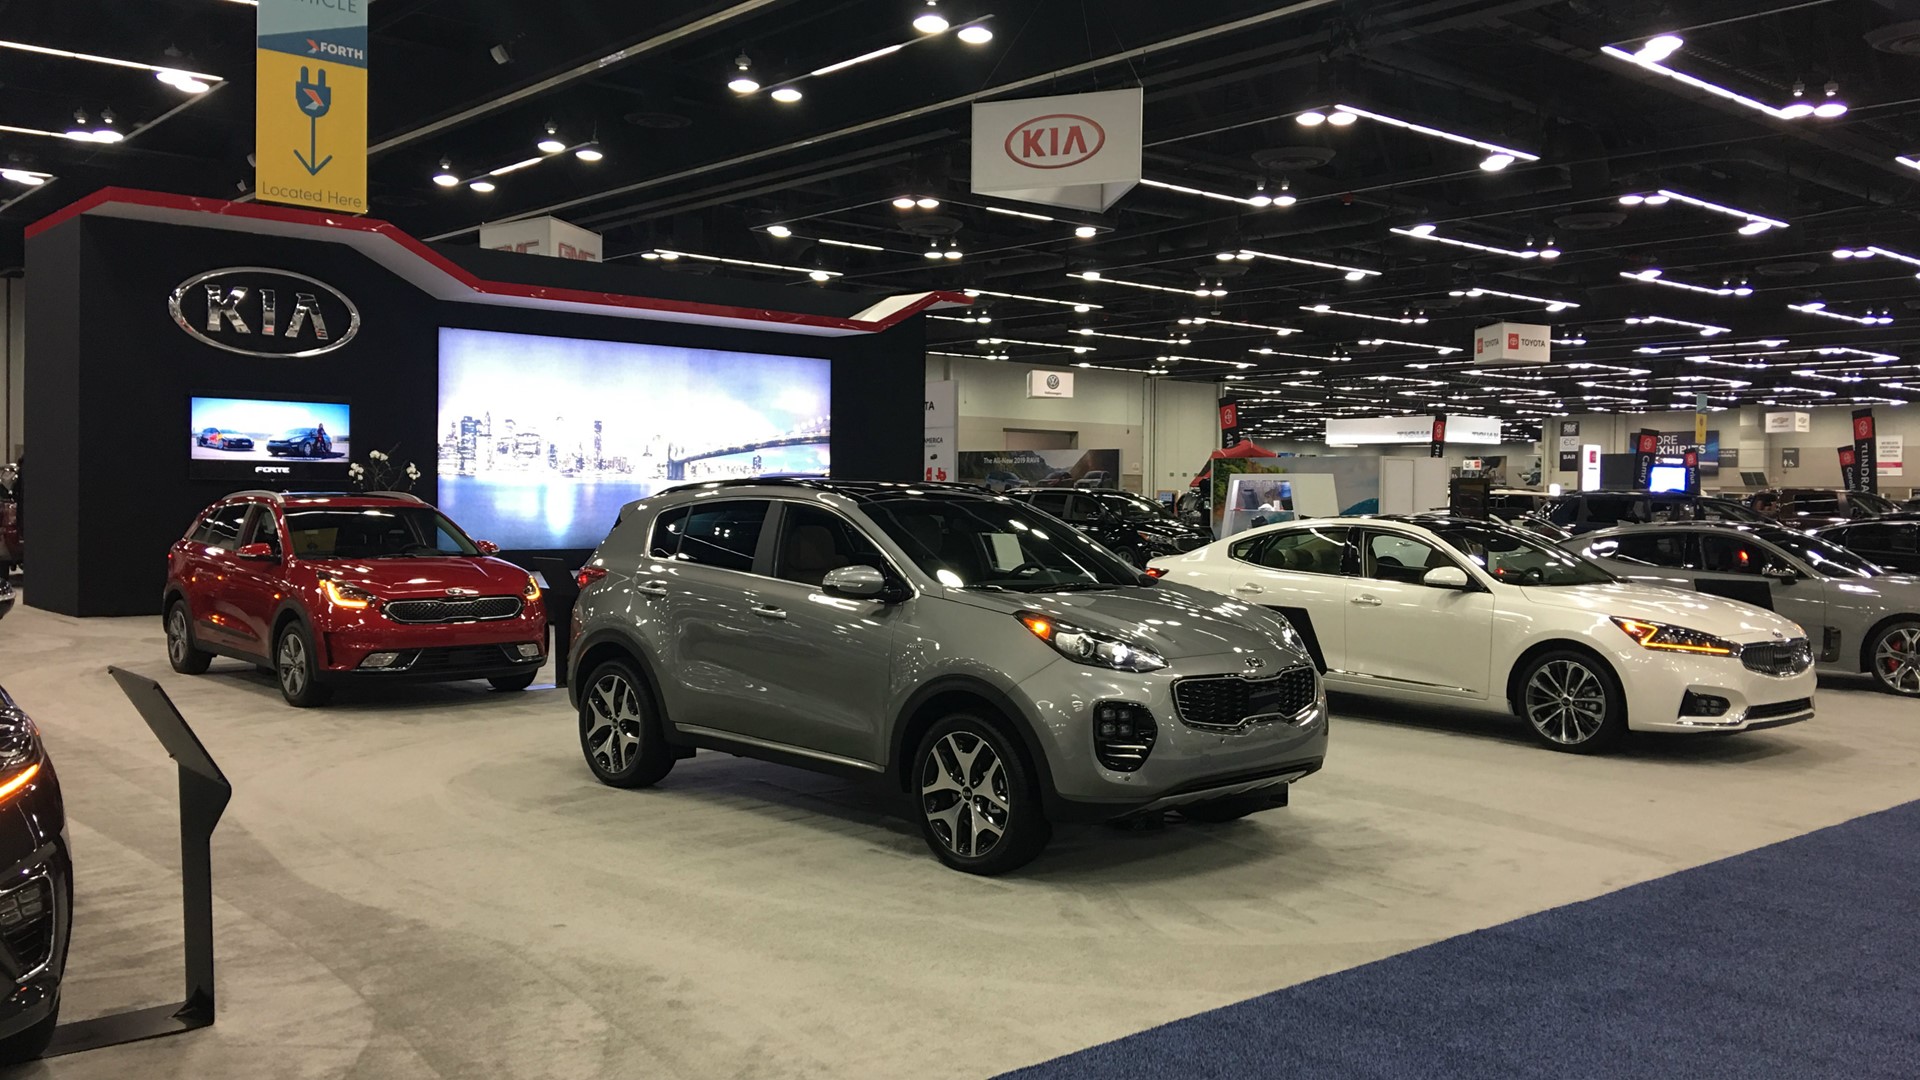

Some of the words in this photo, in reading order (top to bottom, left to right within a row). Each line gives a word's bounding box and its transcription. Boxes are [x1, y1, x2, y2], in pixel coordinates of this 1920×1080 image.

[320, 41, 363, 60] FORTH
[1022, 125, 1088, 158] KIA
[262, 181, 323, 203] Located
[328, 190, 362, 208] Here
[205, 284, 328, 339] KIA
[1484, 338, 1499, 348] TOYOTA
[1521, 338, 1546, 348] TOYOTA
[1656, 434, 1678, 445] ORE
[254, 462, 290, 473] FORTE
[1639, 455, 1650, 485] Camry
[1846, 467, 1857, 492] Coroll
[1861, 442, 1870, 494] TUNDRA
